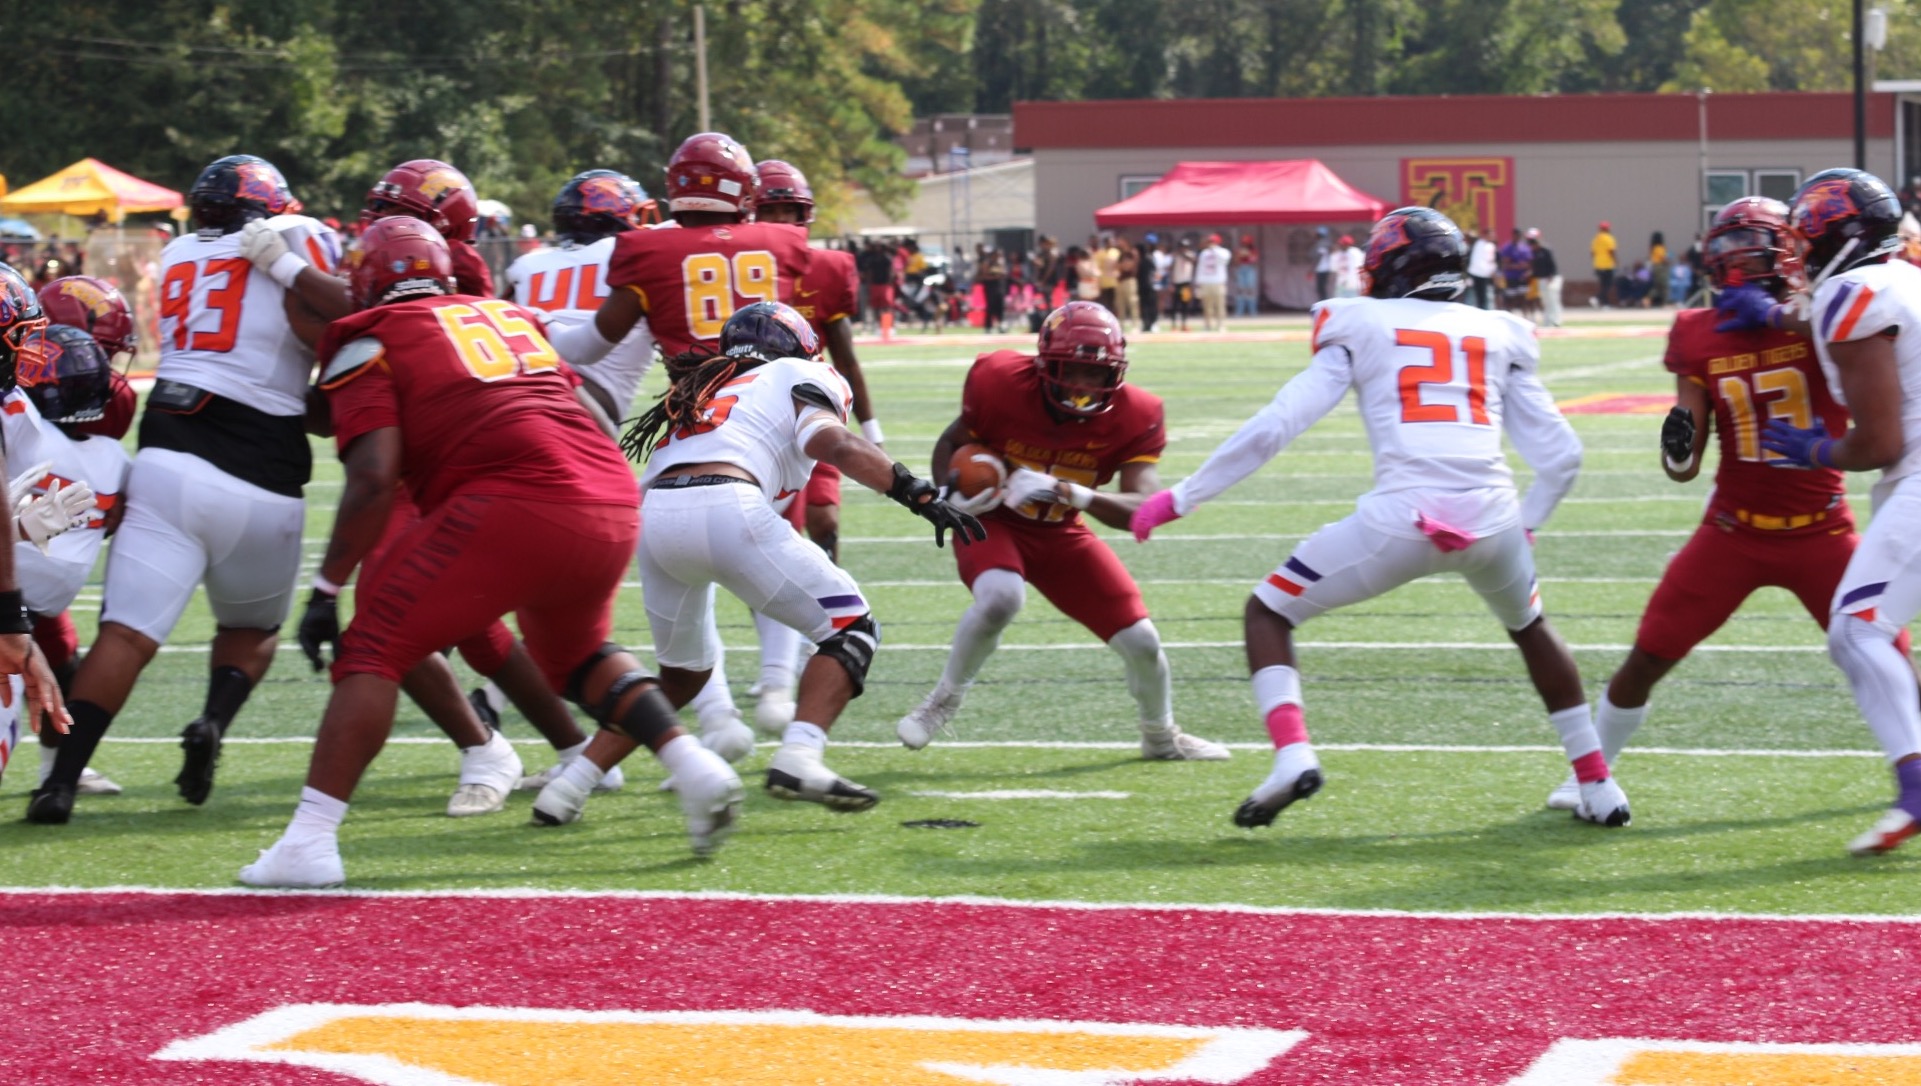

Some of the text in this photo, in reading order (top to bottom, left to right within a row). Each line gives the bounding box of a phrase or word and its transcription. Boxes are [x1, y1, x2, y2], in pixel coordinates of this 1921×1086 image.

[160, 256, 252, 353] 93
[431, 299, 560, 383] 65
[681, 249, 778, 341] 89
[1394, 328, 1491, 426] 21
[1717, 366, 1814, 467] 13
